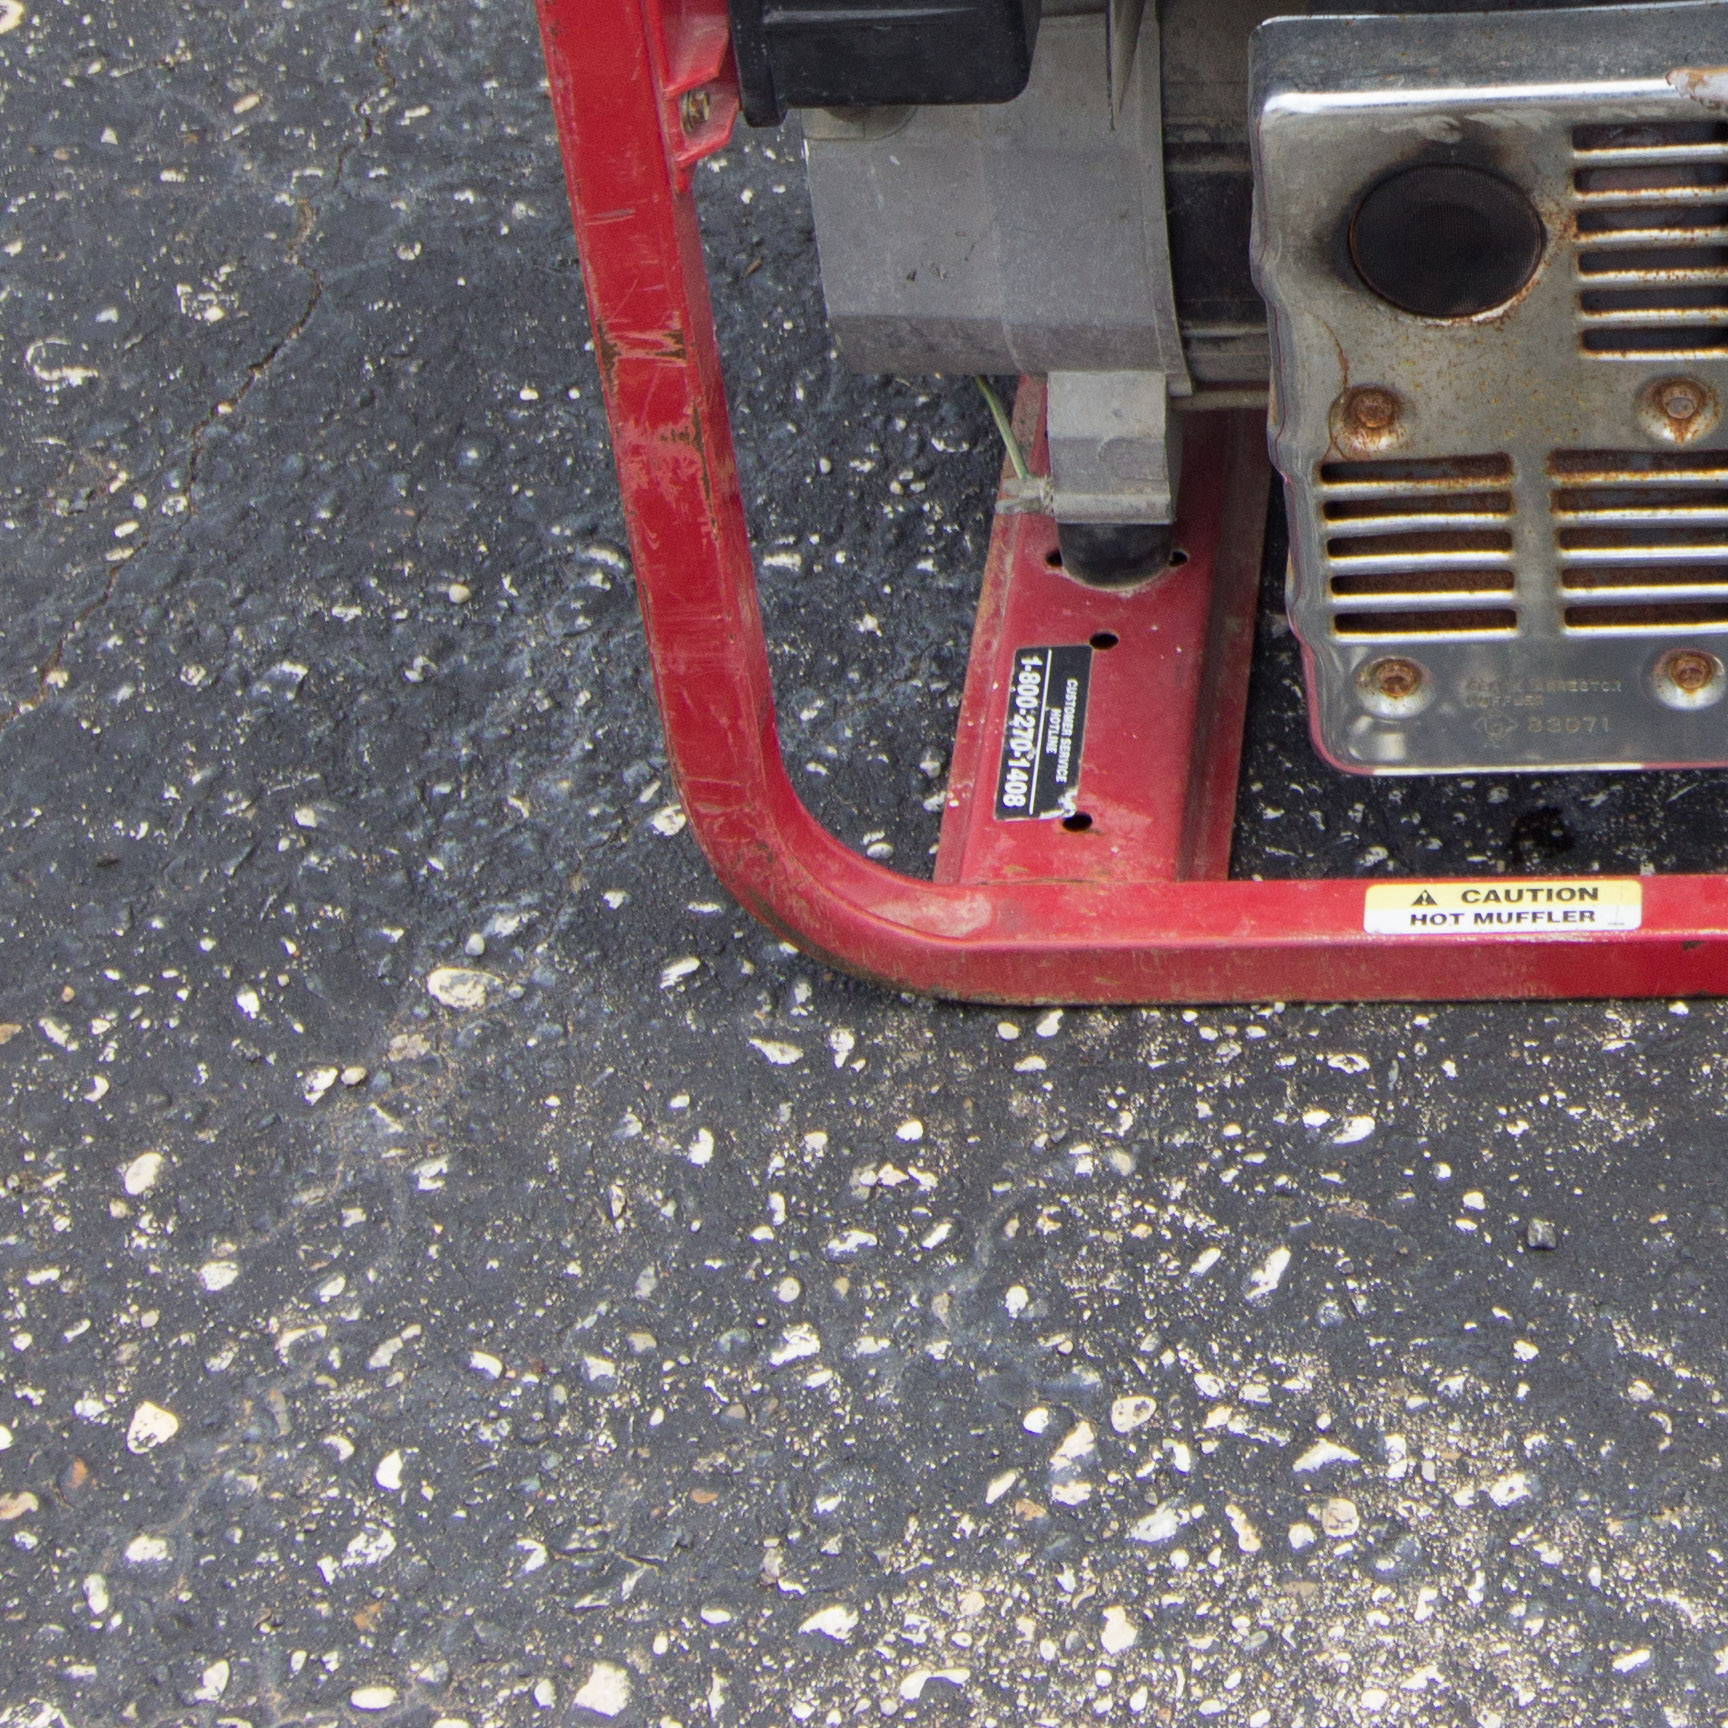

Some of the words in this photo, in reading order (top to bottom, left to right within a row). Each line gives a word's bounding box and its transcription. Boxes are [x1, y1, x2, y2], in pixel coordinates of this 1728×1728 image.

[1045, 707, 1062, 755] HOTLINE
[1060, 678, 1078, 737] CUSTOMER
[1002, 655, 1043, 808] 1-800-270-1408
[1055, 737, 1072, 784] SERVICE
[1410, 912, 1465, 926] HOT
[1473, 910, 1596, 925] MUFFLER
[1461, 887, 1599, 904] CAUTION
